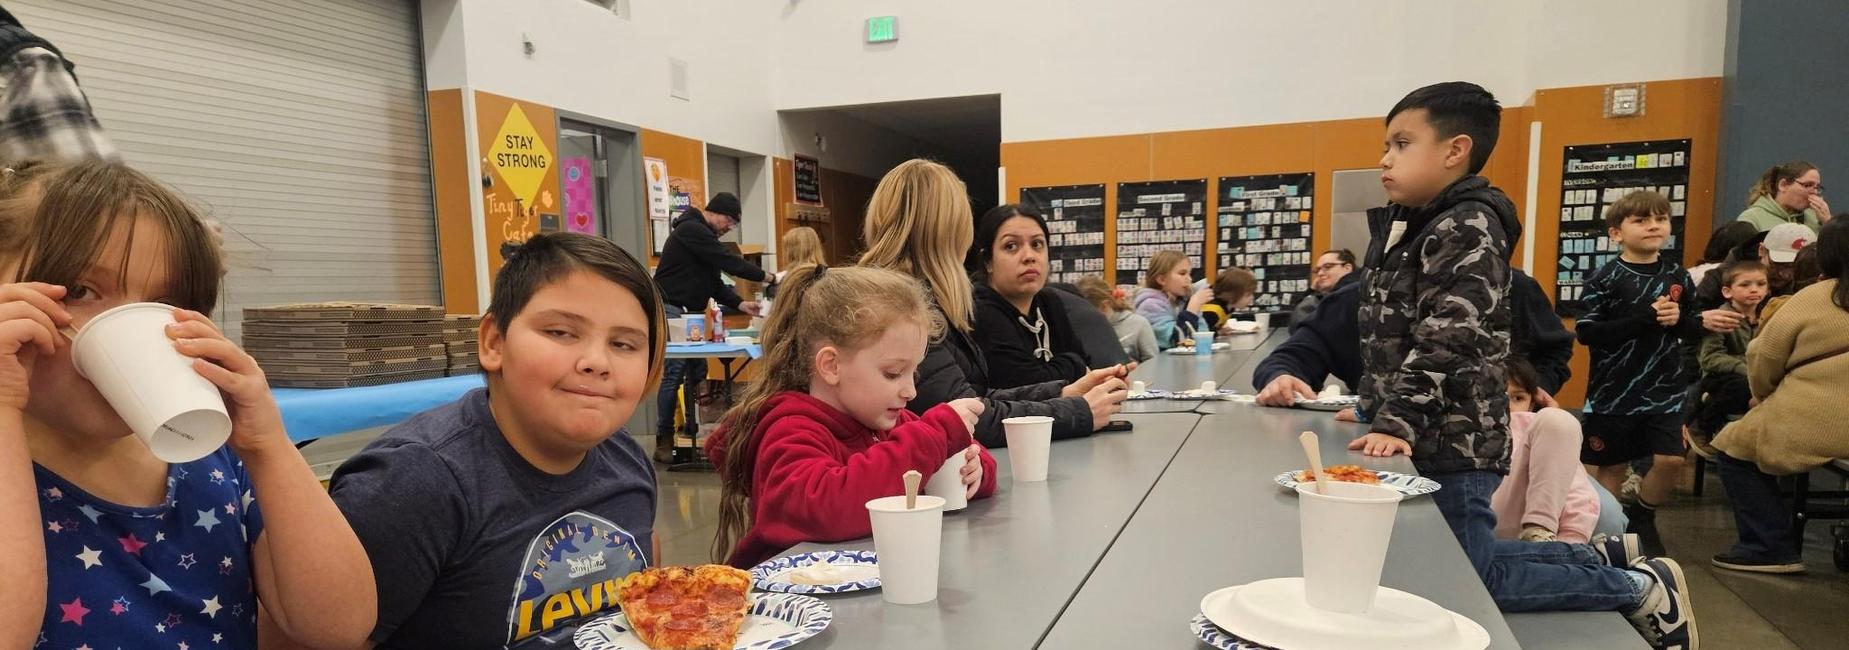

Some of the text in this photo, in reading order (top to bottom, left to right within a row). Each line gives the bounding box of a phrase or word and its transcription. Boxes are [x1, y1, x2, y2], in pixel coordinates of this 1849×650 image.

[505, 134, 533, 149] STAY
[497, 152, 546, 168] STRONG
[1574, 162, 1633, 171] Kindergarten
[486, 193, 514, 221] Tiny
[533, 523, 581, 580] ORIGINAL
[591, 529, 636, 561] DENIM
